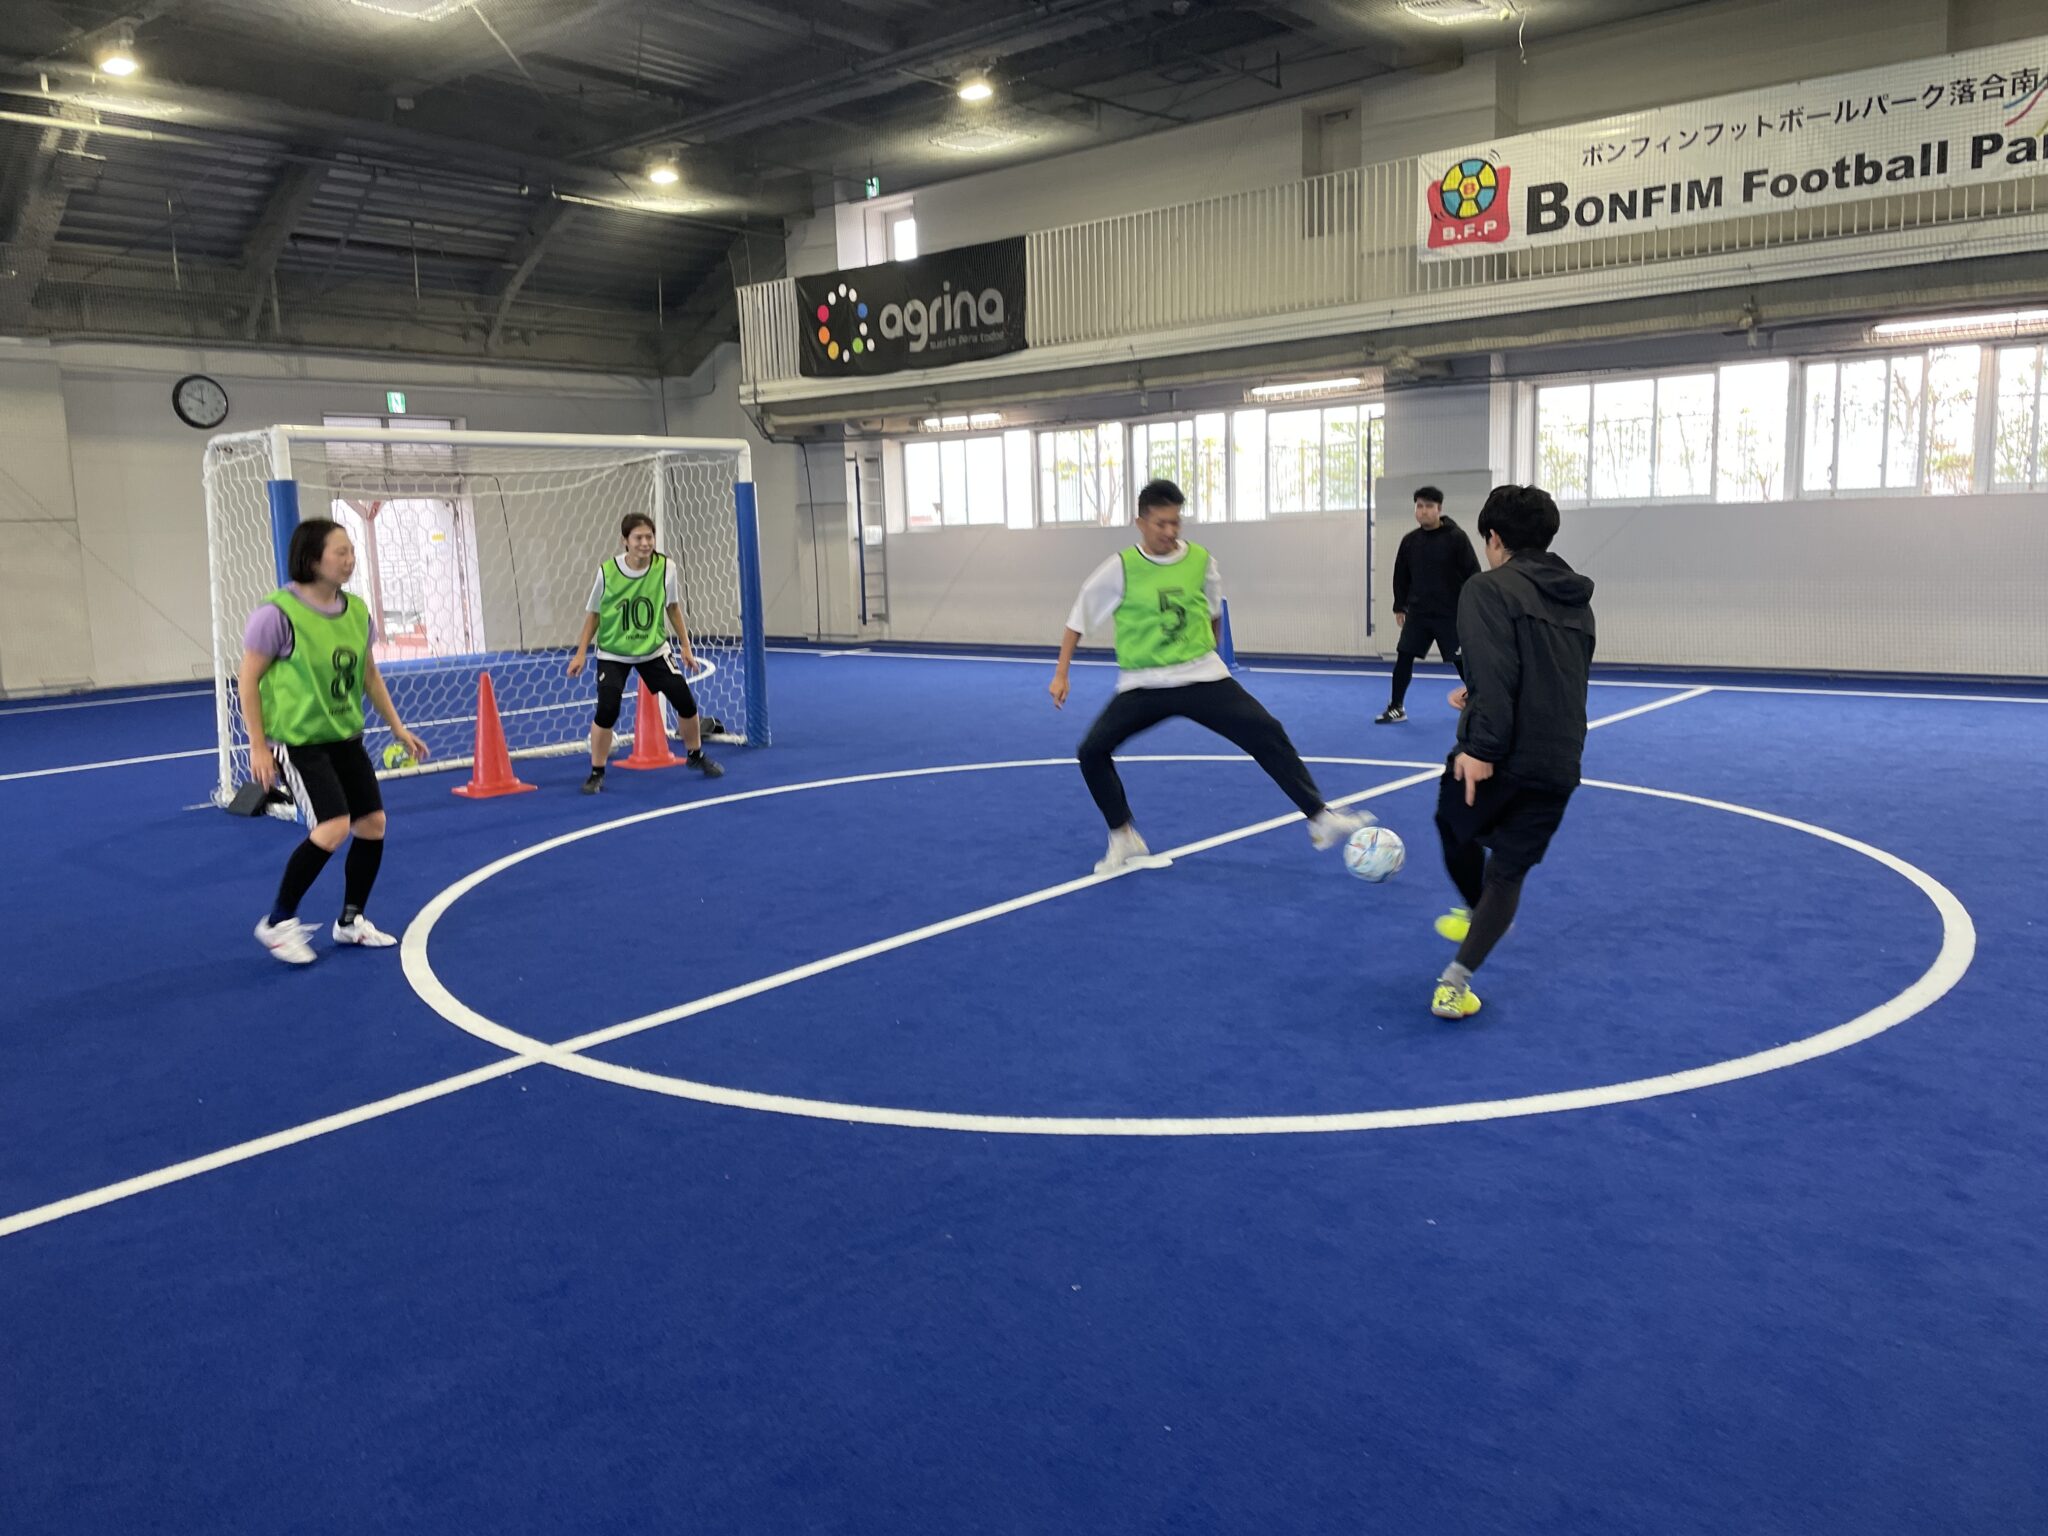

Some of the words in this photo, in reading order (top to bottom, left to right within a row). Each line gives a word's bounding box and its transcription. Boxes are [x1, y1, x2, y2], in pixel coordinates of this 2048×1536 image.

[1742, 140, 1949, 203] Football
[879, 280, 1005, 353] agrina
[615, 596, 655, 632] 10
[1158, 587, 1187, 637] 5
[331, 646, 358, 702] 8
